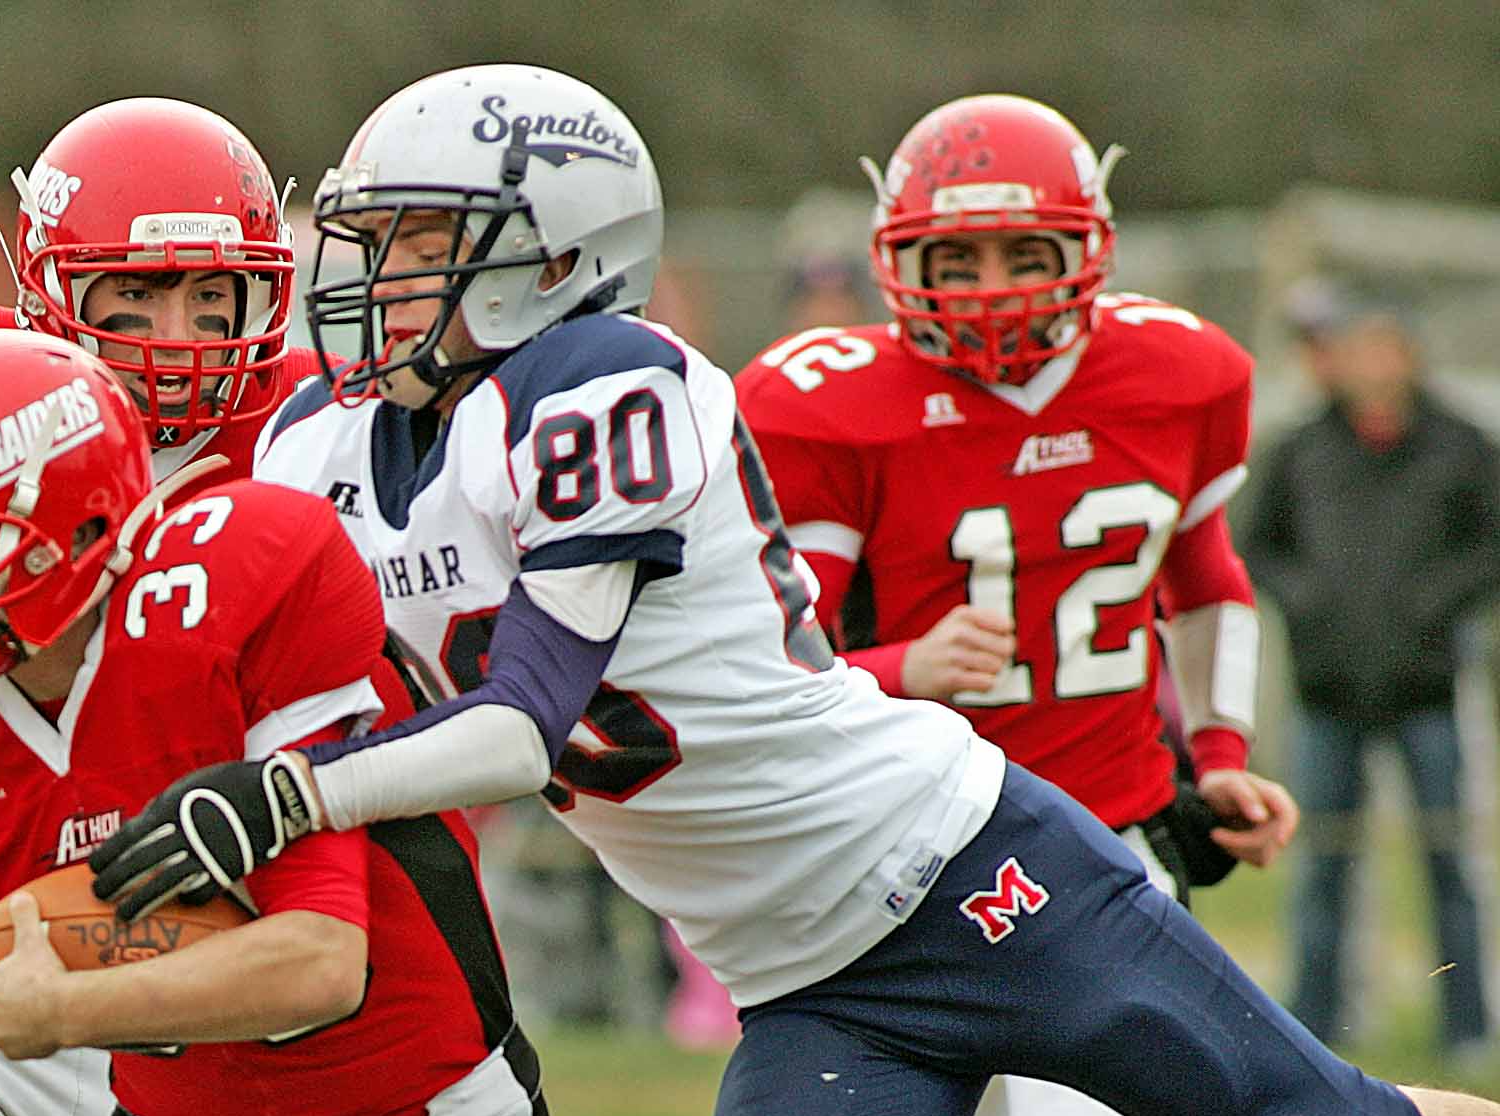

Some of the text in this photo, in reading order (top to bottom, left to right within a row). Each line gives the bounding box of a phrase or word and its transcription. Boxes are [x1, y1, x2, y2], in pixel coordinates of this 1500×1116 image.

[533, 388, 674, 522] 80
[372, 545, 466, 599] HAR
[949, 482, 1181, 707] 12
[959, 856, 1051, 945] M
